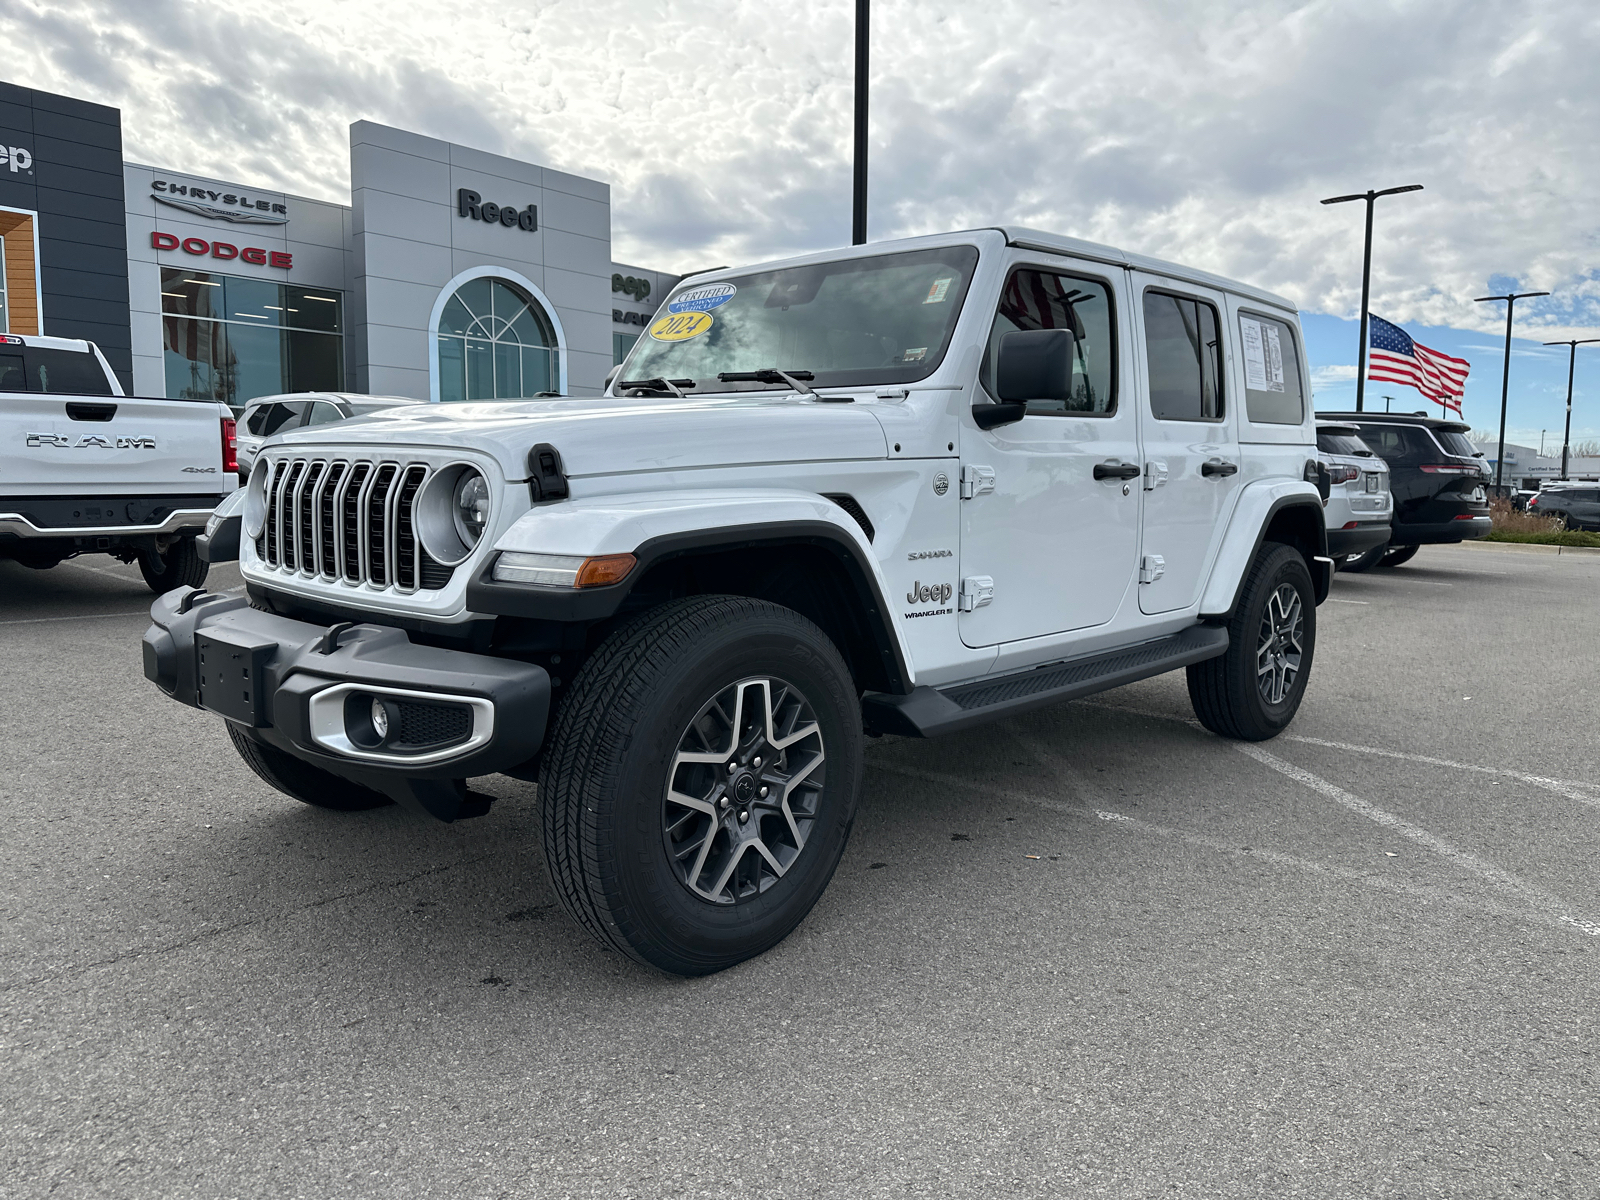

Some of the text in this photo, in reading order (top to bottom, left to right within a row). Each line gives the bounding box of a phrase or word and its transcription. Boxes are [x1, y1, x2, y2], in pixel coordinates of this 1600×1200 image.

[151, 180, 288, 214] CHRYSLER
[457, 187, 538, 232] Reed
[150, 231, 293, 269] DODGE
[675, 296, 723, 309] PRE-OWNED
[678, 286, 731, 303] CERTIFIED
[680, 303, 713, 312] VEHICLE
[654, 314, 707, 335] 2024
[26, 431, 157, 449] RAM
[907, 548, 953, 561] SAHARA
[906, 579, 953, 605] Jeep
[904, 608, 946, 620] WRANGLER
